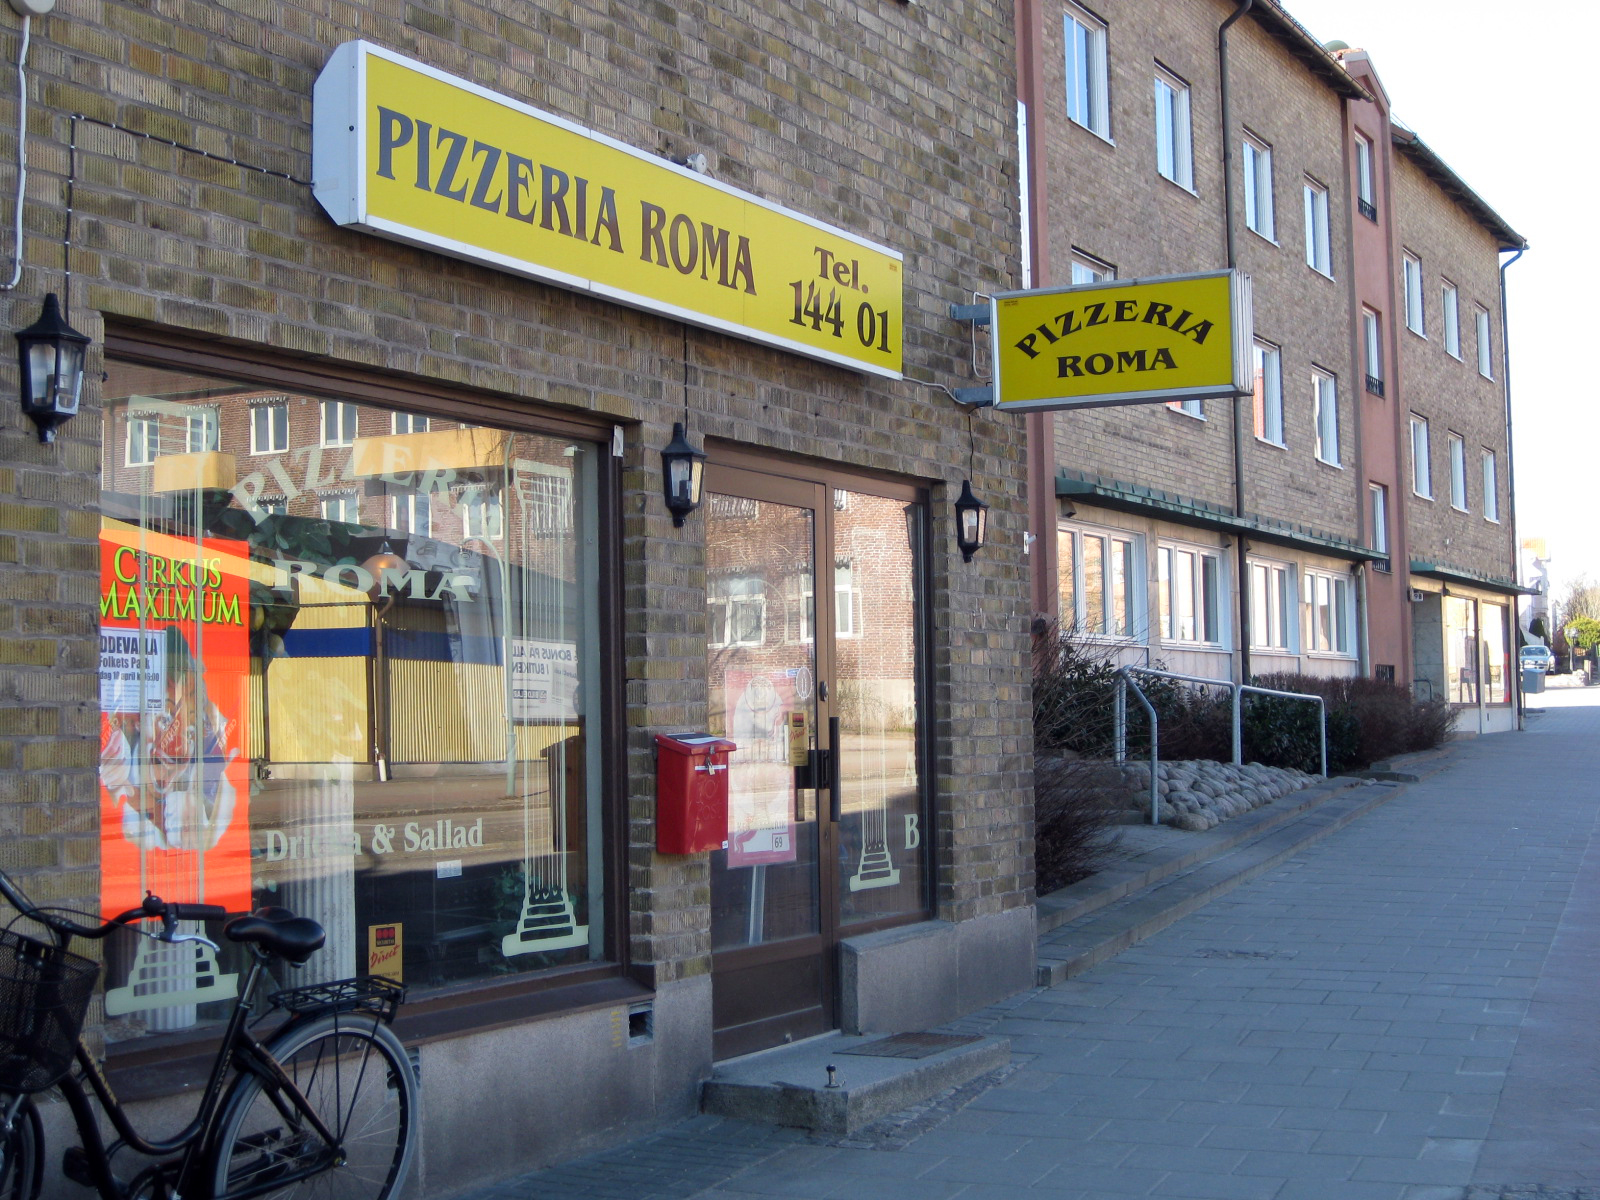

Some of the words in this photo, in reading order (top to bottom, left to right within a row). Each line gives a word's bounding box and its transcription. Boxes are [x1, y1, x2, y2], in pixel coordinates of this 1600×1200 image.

[376, 105, 624, 254] PIZZERIA
[639, 200, 757, 296] ROMA
[814, 246, 868, 294] Tel.
[789, 279, 845, 339] 144
[857, 302, 892, 354] 01
[1013, 300, 1214, 360] PIZZERIA
[1056, 347, 1179, 379] ROMA
[114, 546, 222, 589] CRKUS
[271, 559, 475, 602] ROMA
[100, 580, 243, 626] MAXIMUM
[101, 635, 158, 656] DDEVALA
[131, 657, 151, 670] Pak
[371, 823, 396, 855] &
[403, 817, 484, 852] Sallad
[774, 836, 783, 848] 69
